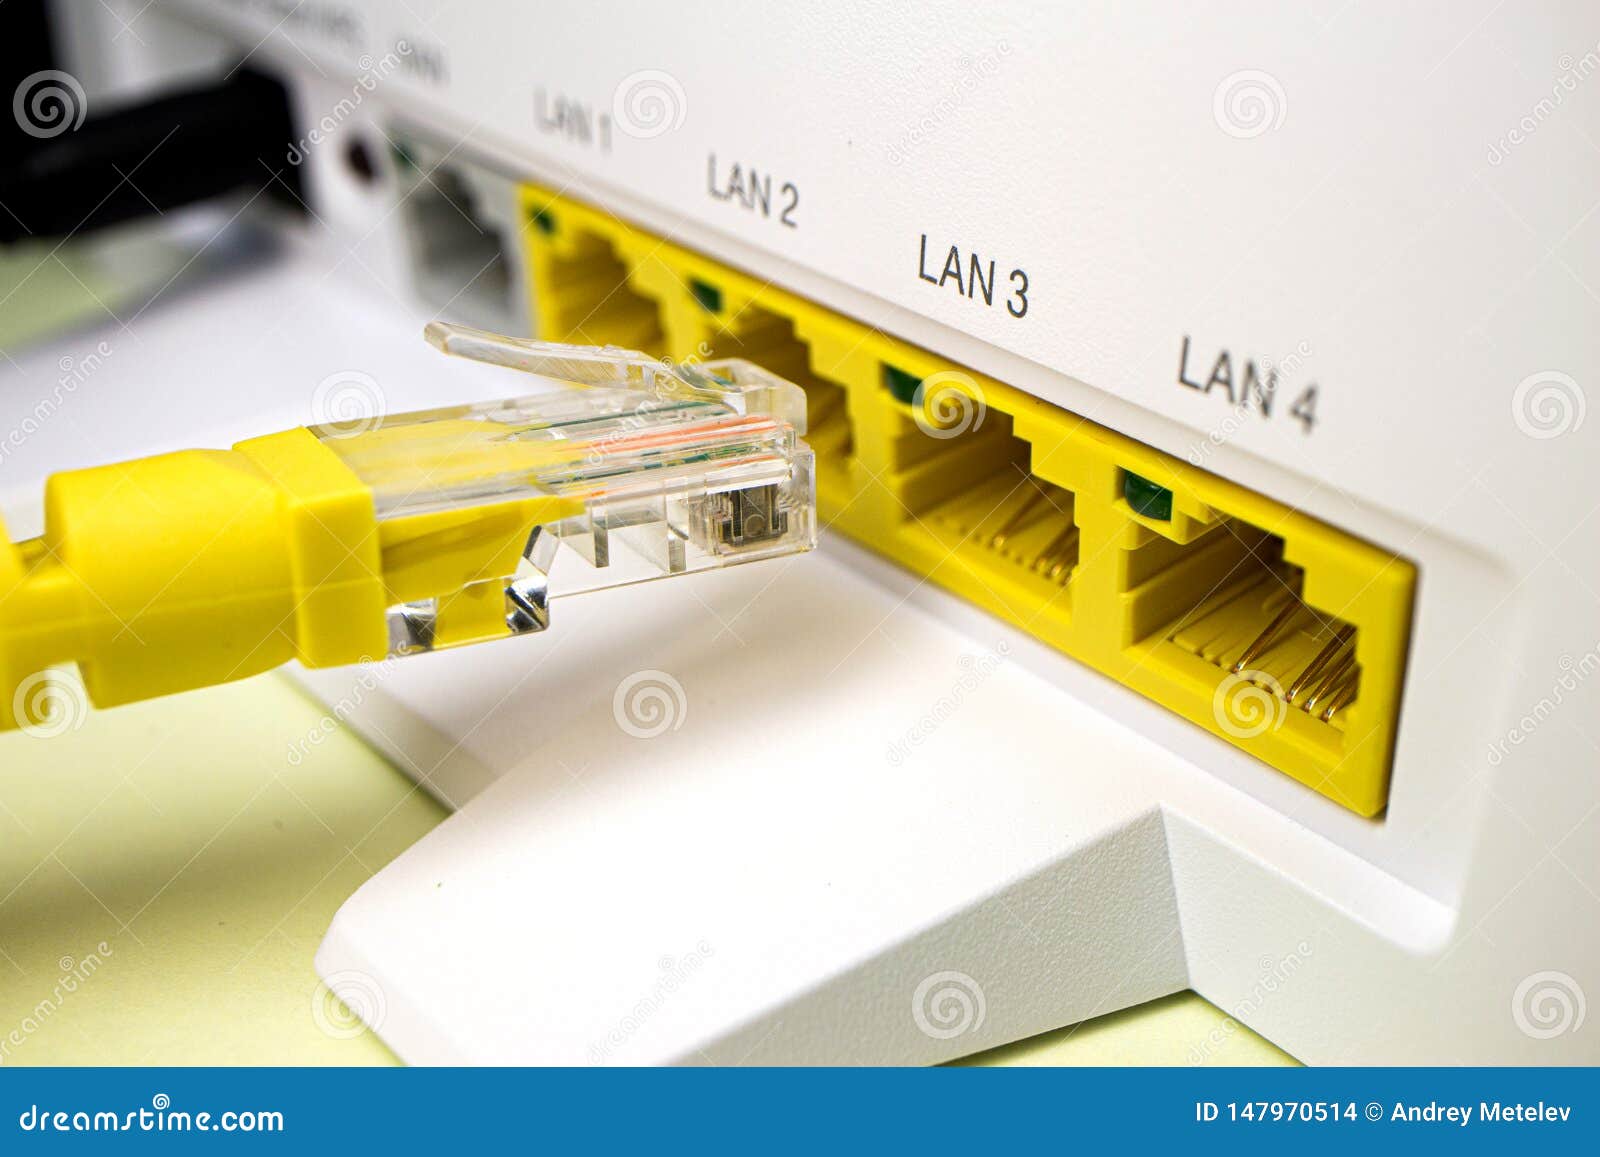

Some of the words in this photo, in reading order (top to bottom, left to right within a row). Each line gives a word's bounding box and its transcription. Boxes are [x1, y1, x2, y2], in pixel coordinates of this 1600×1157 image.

[534, 85, 592, 145] LAN
[600, 112, 611, 153] 1
[708, 153, 772, 217] LAN
[781, 182, 799, 228] 2
[918, 234, 995, 306] LAN
[1006, 269, 1030, 318] 3
[1179, 334, 1277, 418] LAN
[1290, 383, 1318, 435] 4
